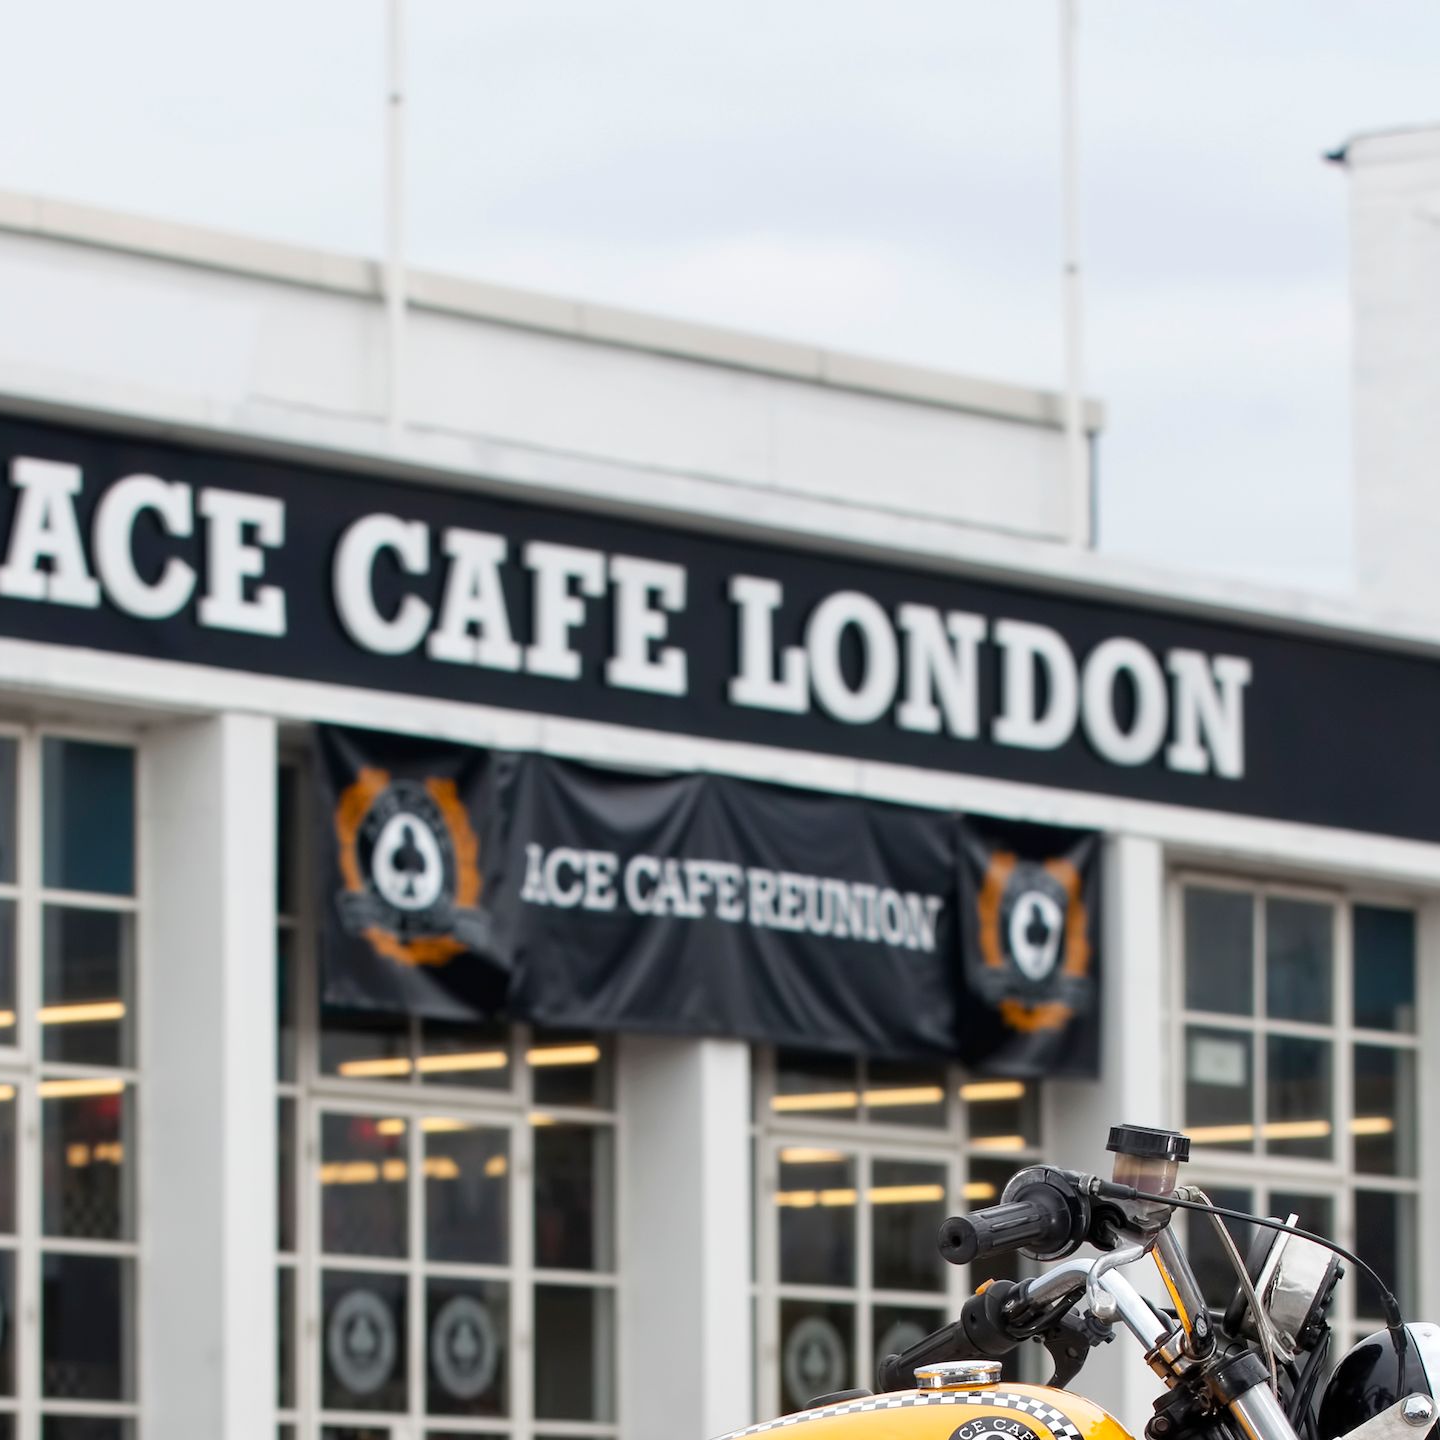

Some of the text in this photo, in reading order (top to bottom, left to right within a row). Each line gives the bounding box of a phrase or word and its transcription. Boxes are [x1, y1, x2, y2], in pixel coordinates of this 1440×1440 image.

[333, 512, 688, 696] CAFE
[728, 574, 1252, 779] LONDON
[520, 843, 618, 911] ACE
[623, 855, 746, 923] CAFE
[747, 867, 943, 953] REUNION
